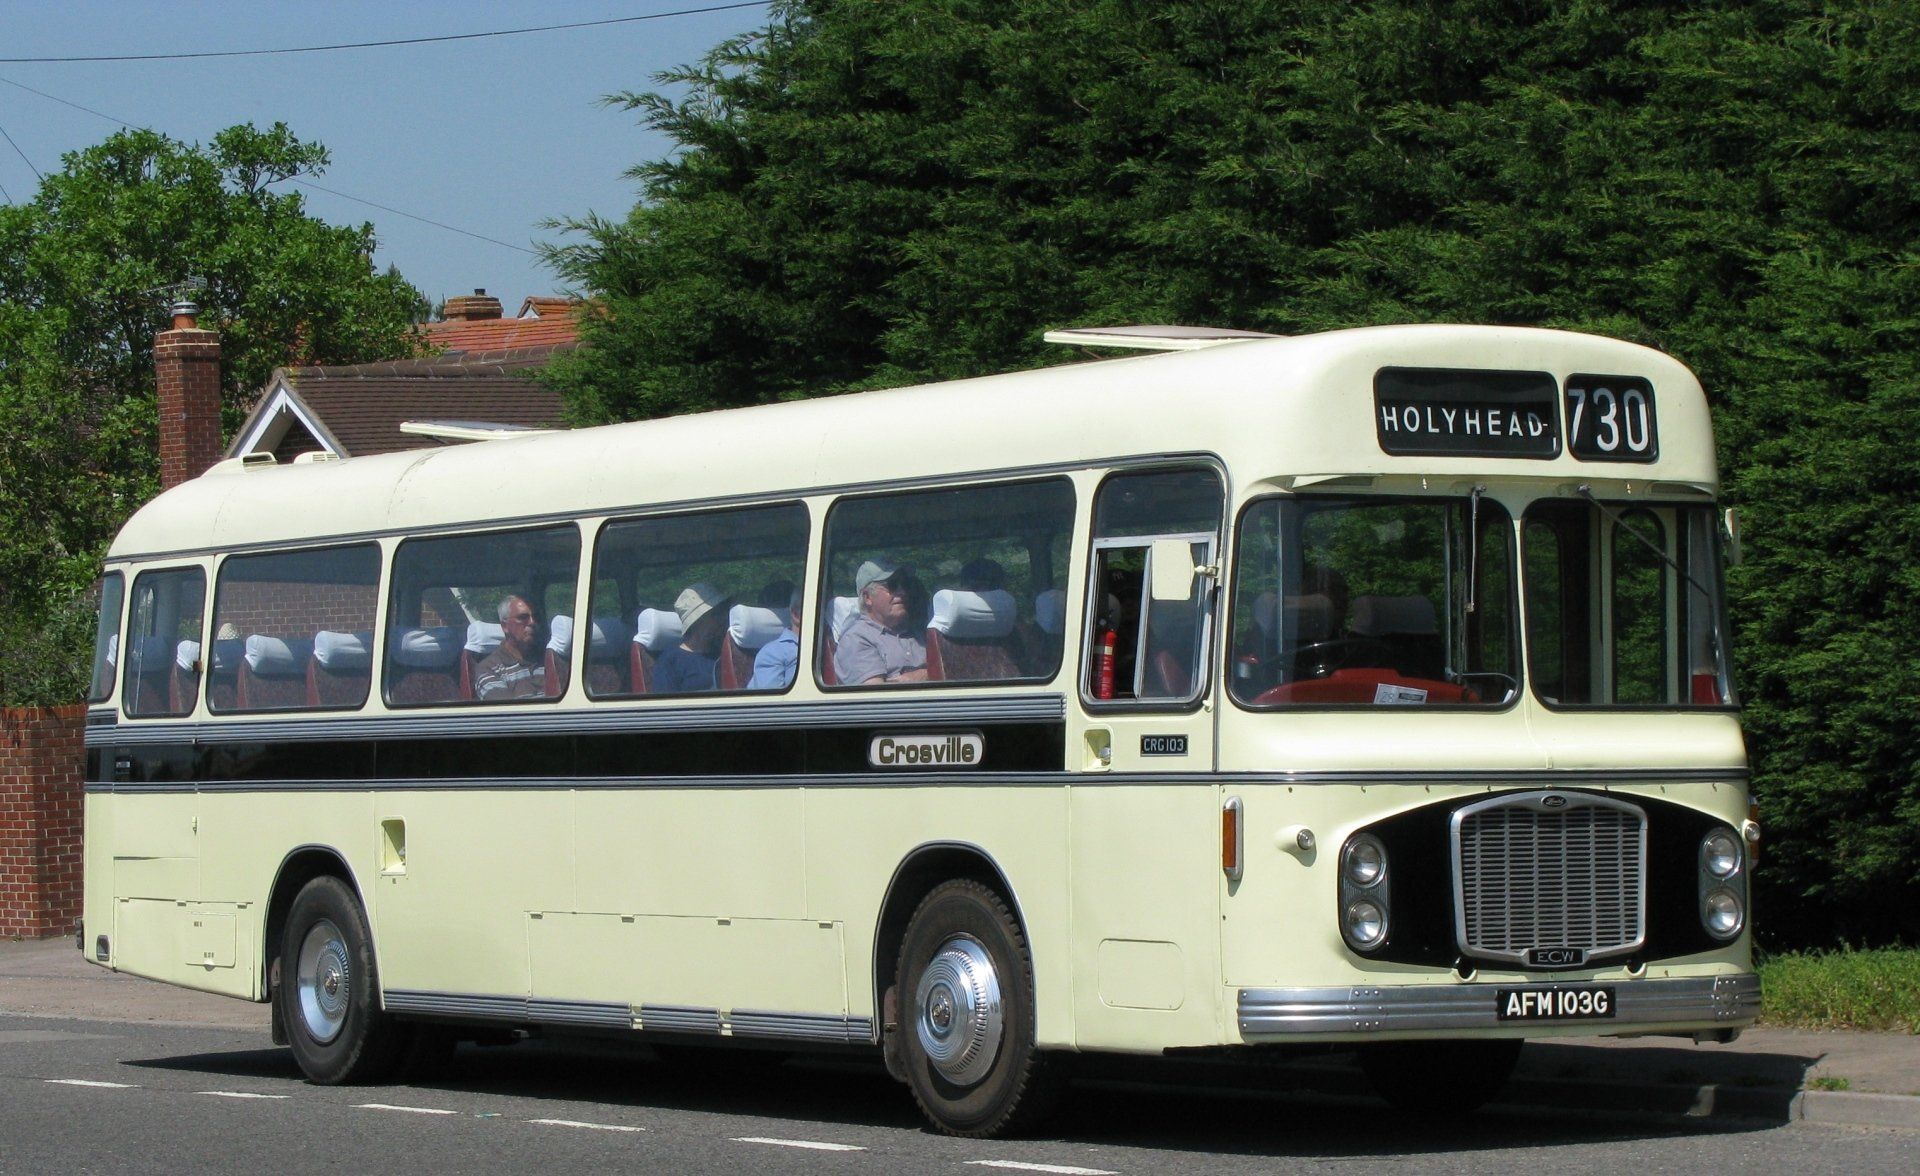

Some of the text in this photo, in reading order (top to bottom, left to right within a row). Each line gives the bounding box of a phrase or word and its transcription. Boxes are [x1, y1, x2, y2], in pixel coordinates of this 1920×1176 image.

[1567, 387, 1650, 452] 730
[878, 737, 975, 764] Crosville
[1537, 950, 1574, 963] ECW
